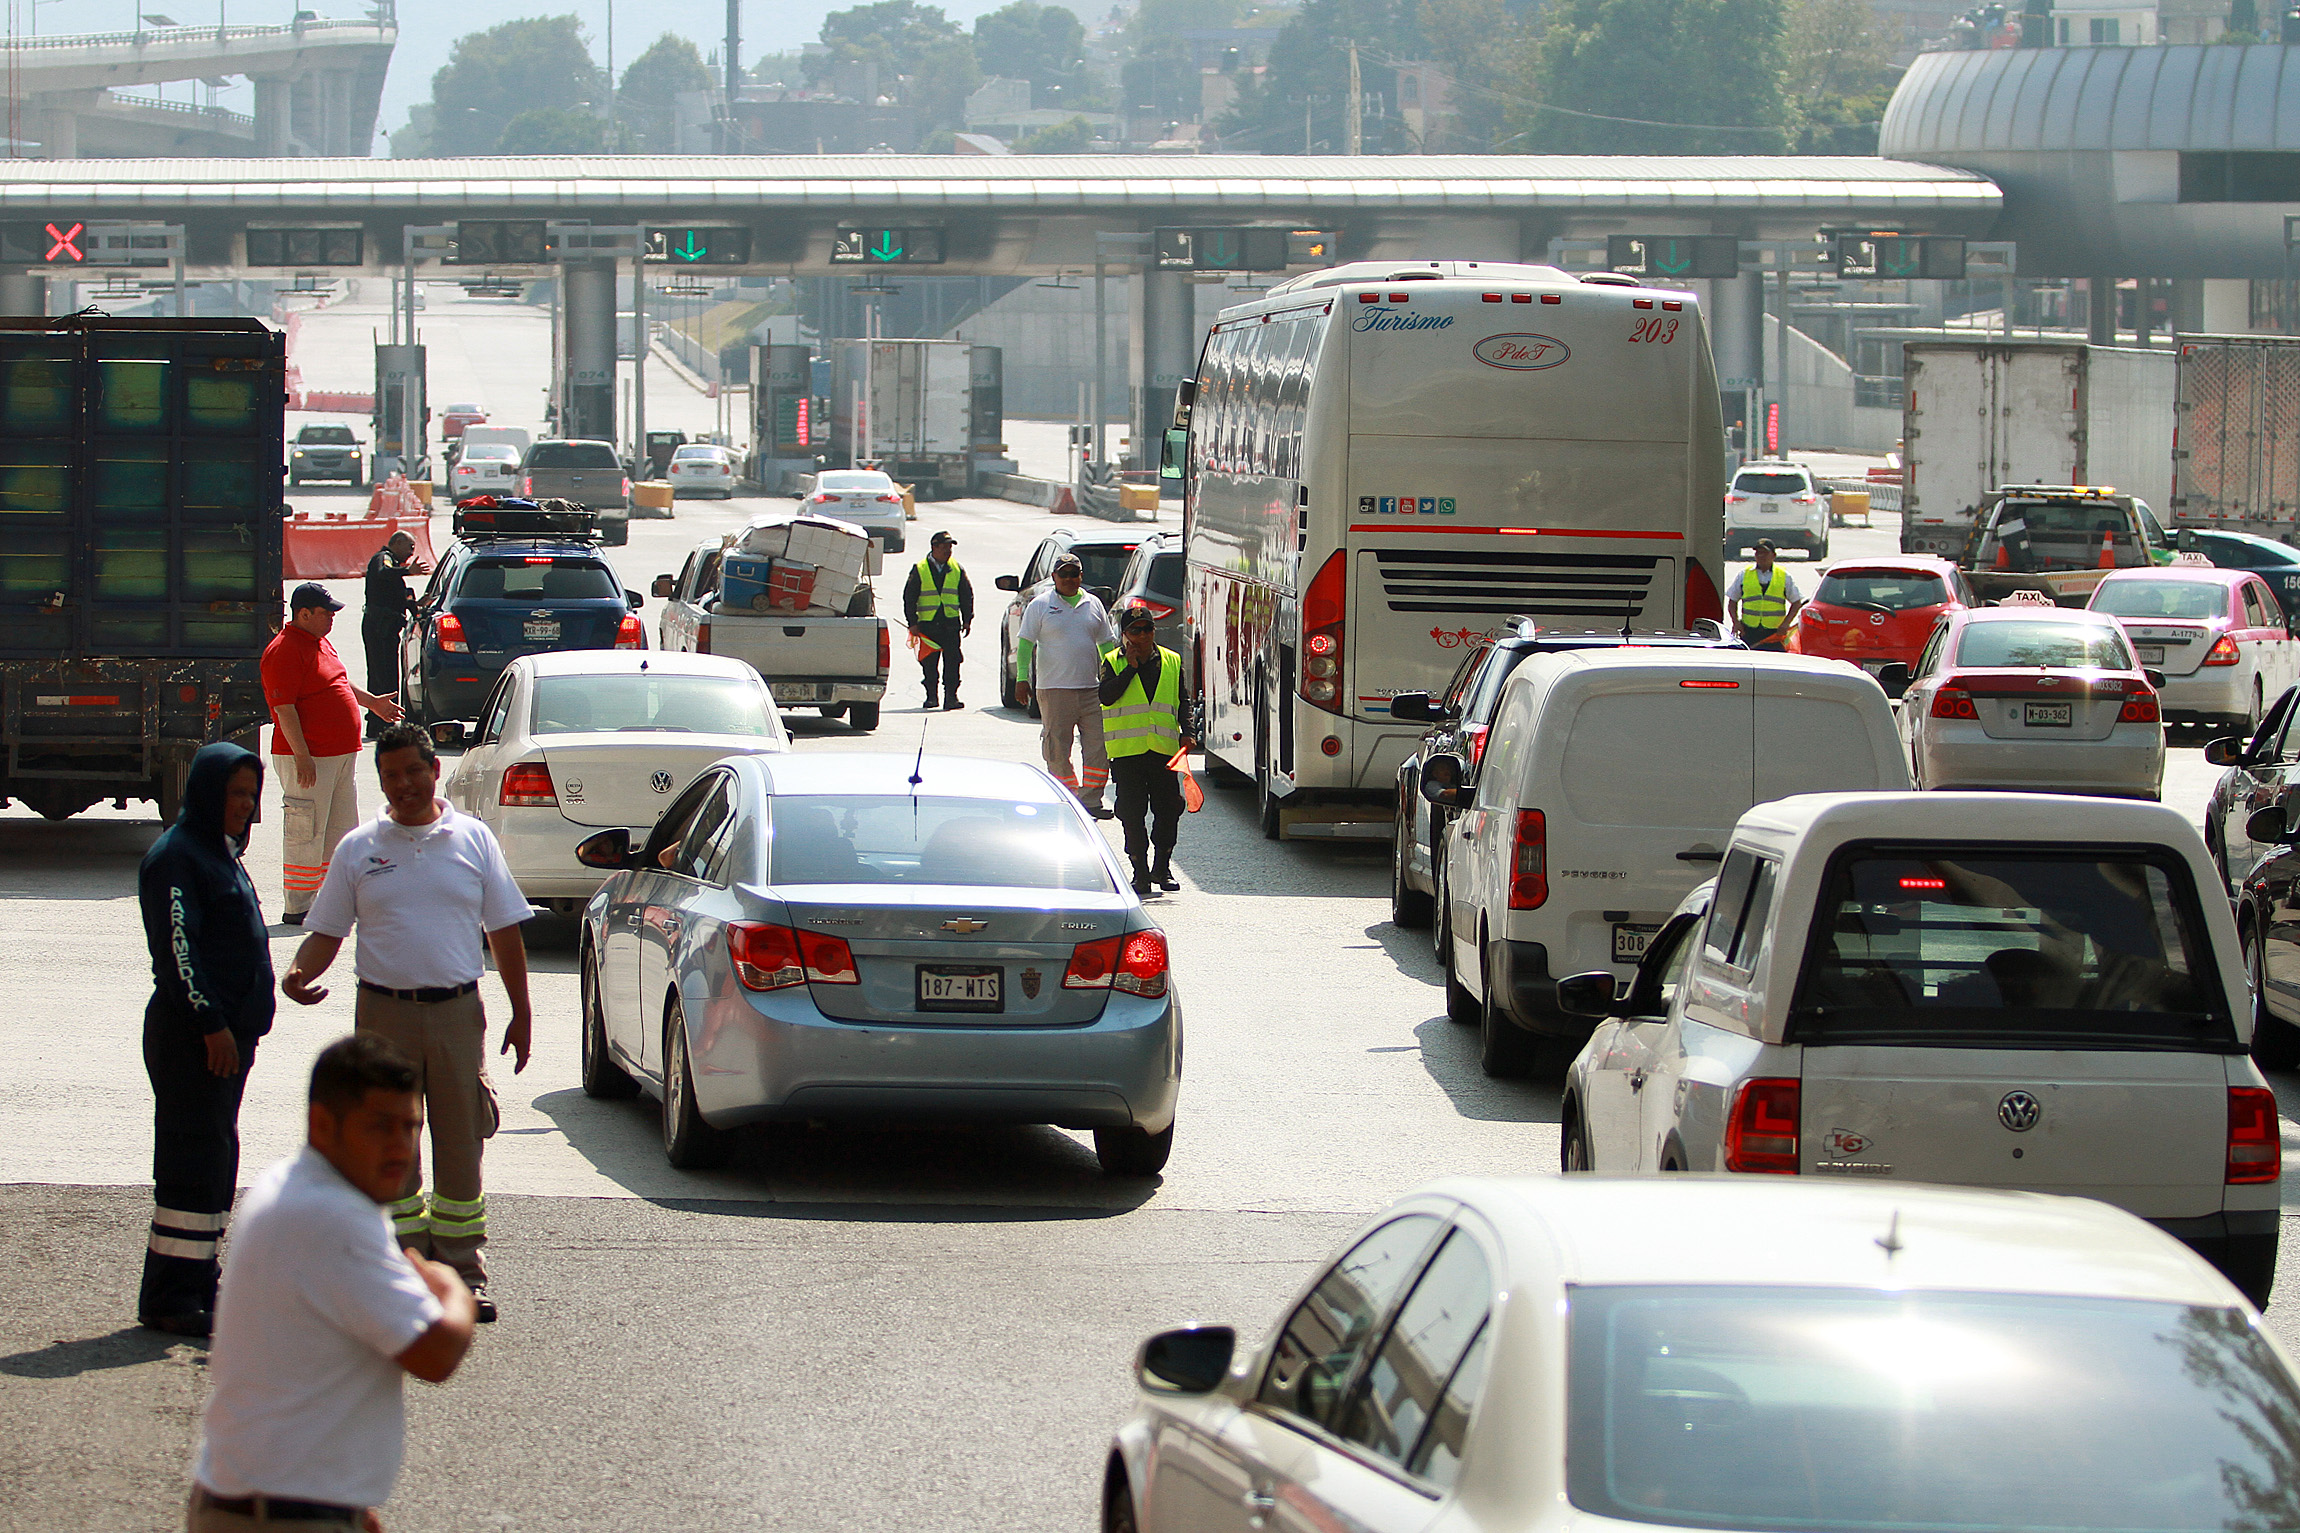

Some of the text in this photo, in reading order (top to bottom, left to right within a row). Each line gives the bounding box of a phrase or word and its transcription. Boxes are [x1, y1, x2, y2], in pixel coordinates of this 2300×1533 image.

[1352, 306, 1454, 333] Turismo
[1628, 317, 1678, 344] 203
[2182, 553, 2201, 561] TAXI
[2016, 593, 2040, 601] TAXI
[2171, 630, 2205, 639] A-1779-J
[1561, 870, 1627, 879] PEUGEOT
[1060, 921, 1097, 930] CRUZE
[925, 978, 997, 998] 187-WTS
[1815, 1161, 1894, 1175] SAVEIRO
